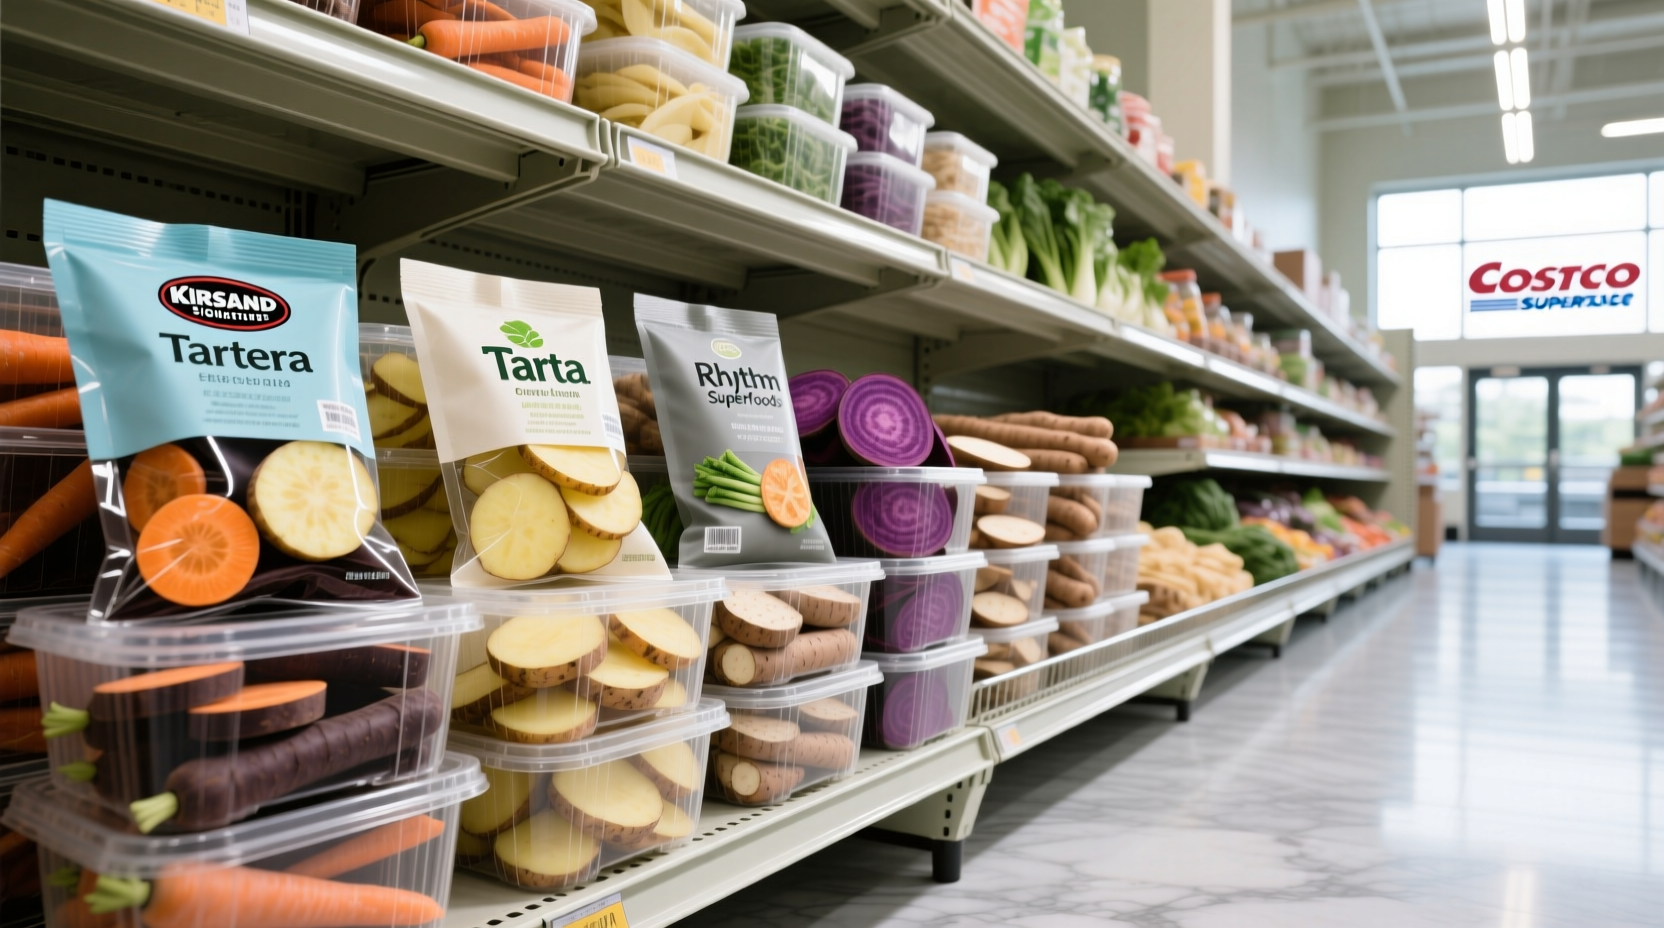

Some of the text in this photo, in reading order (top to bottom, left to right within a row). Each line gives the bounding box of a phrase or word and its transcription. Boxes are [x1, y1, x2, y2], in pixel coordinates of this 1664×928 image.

[1469, 261, 1641, 294] COSTCO
[169, 285, 277, 312] KIRSAND
[158, 332, 314, 373] Tartera
